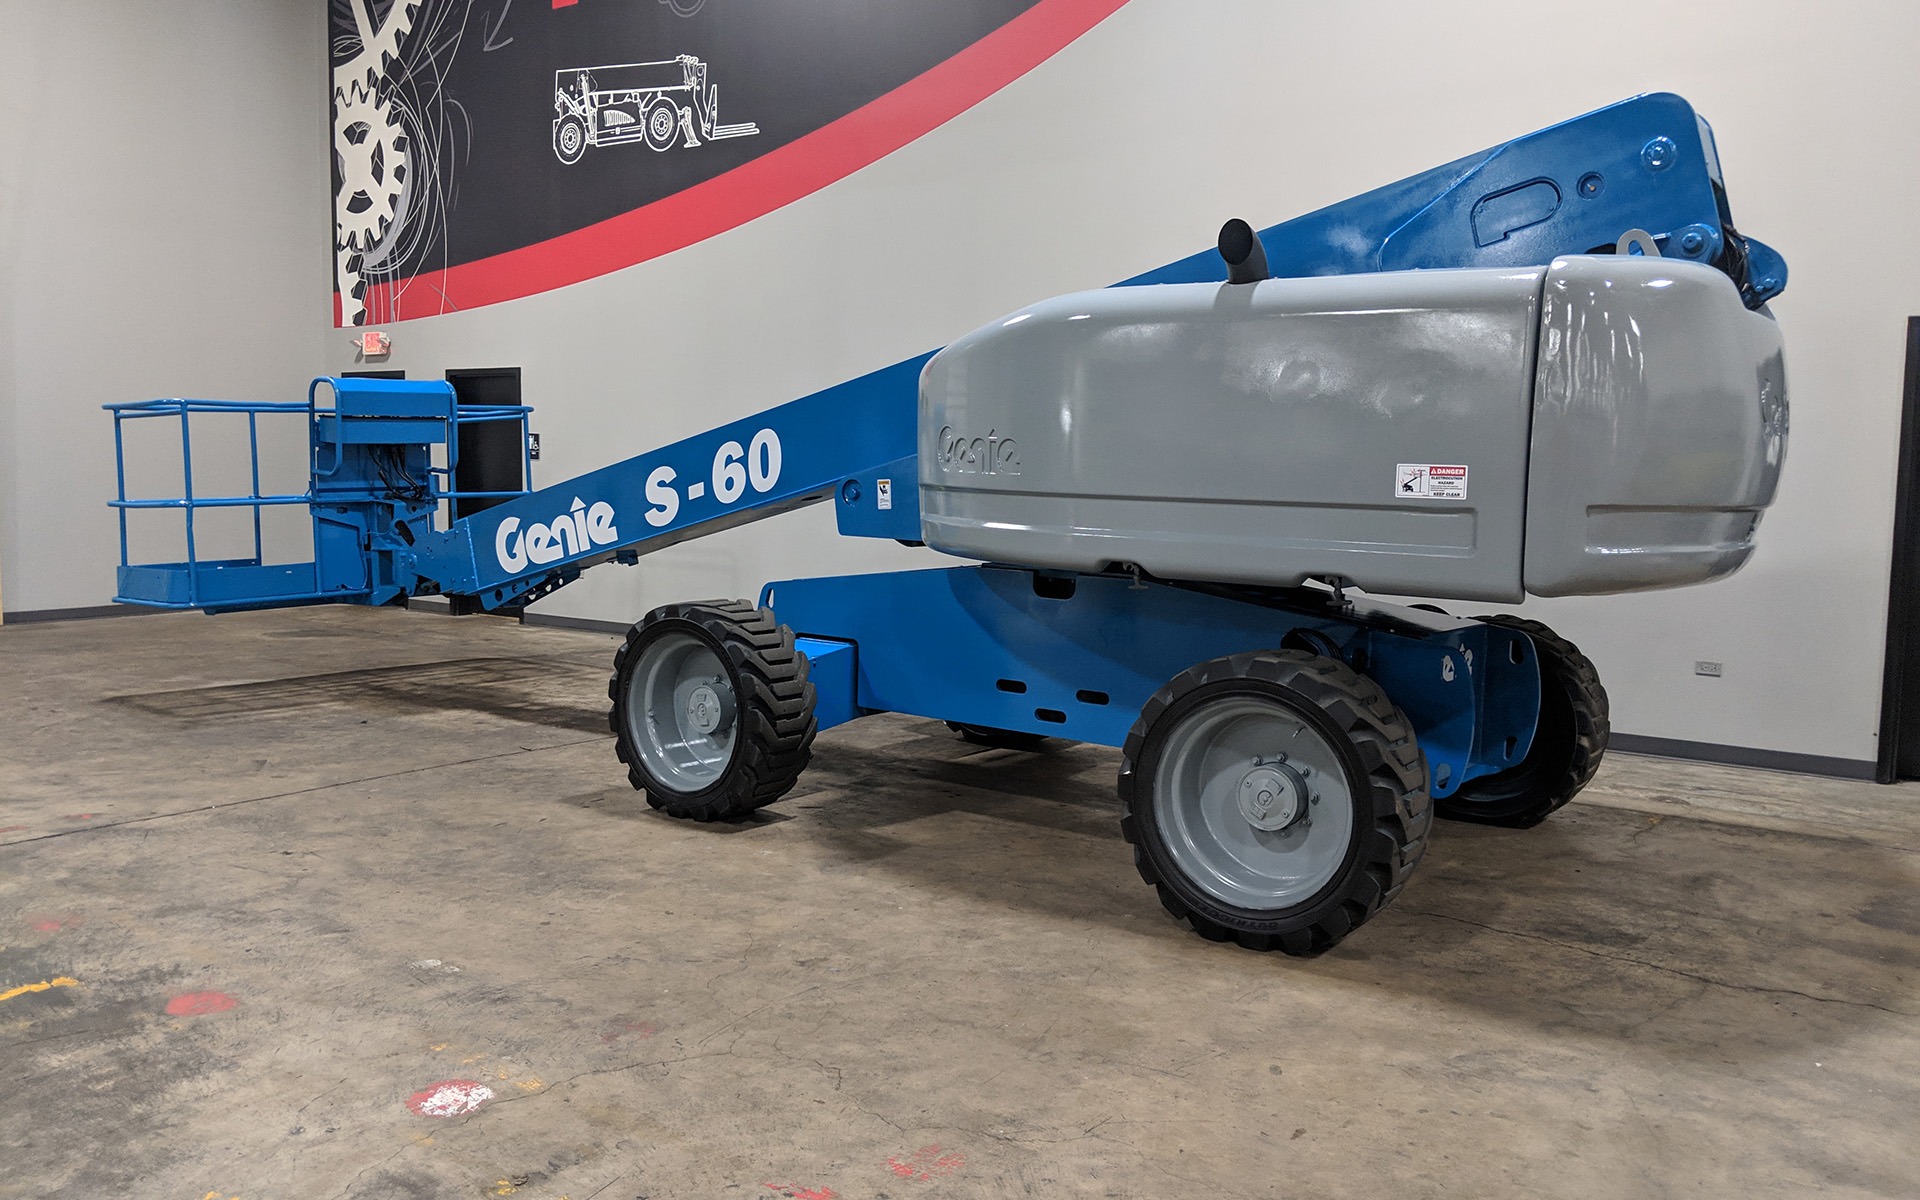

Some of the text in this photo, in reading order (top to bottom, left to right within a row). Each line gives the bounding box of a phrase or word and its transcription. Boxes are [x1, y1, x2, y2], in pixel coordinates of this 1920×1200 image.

[938, 425, 1021, 475] Genie
[495, 428, 782, 574] Genie S-60
